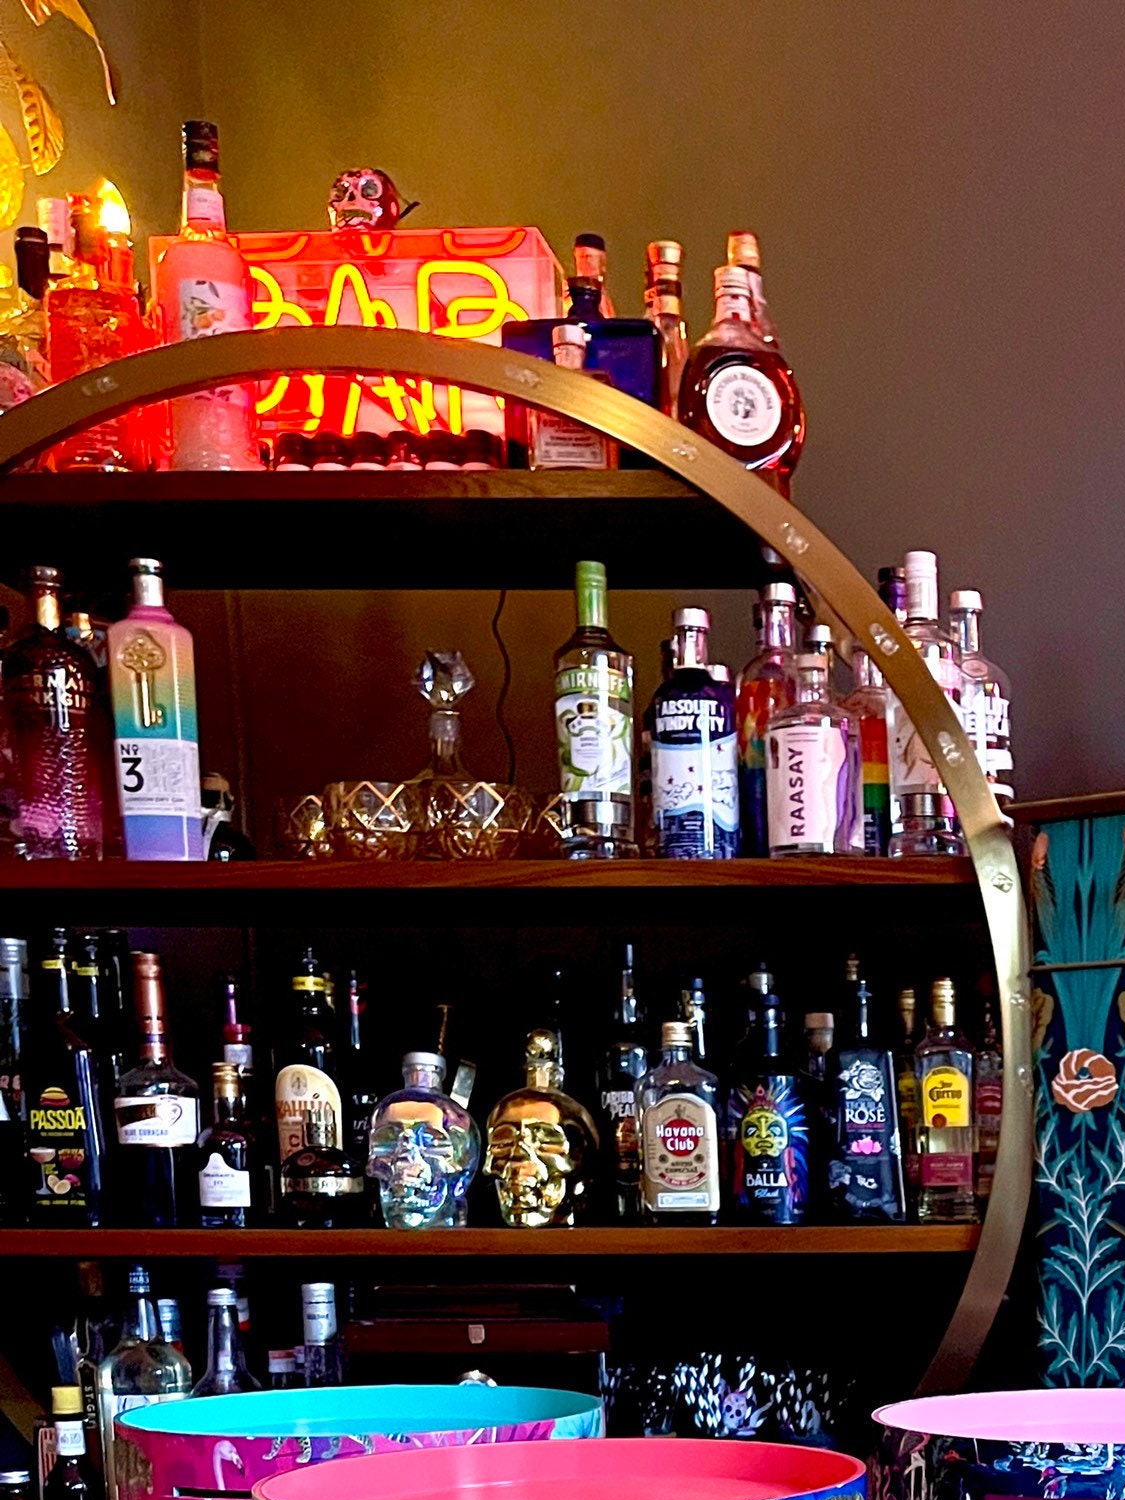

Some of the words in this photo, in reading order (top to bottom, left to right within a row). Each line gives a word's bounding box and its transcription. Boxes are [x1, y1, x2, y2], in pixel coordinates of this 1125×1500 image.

[696, 715, 725, 733] CTY
[121, 757, 144, 793] 3
[787, 747, 806, 837] RAASAY
[845, 1109, 886, 1125] ROSE
[655, 1124, 704, 1138] Havana
[666, 1137, 695, 1151] Club
[746, 1172, 788, 1187] BALLA
